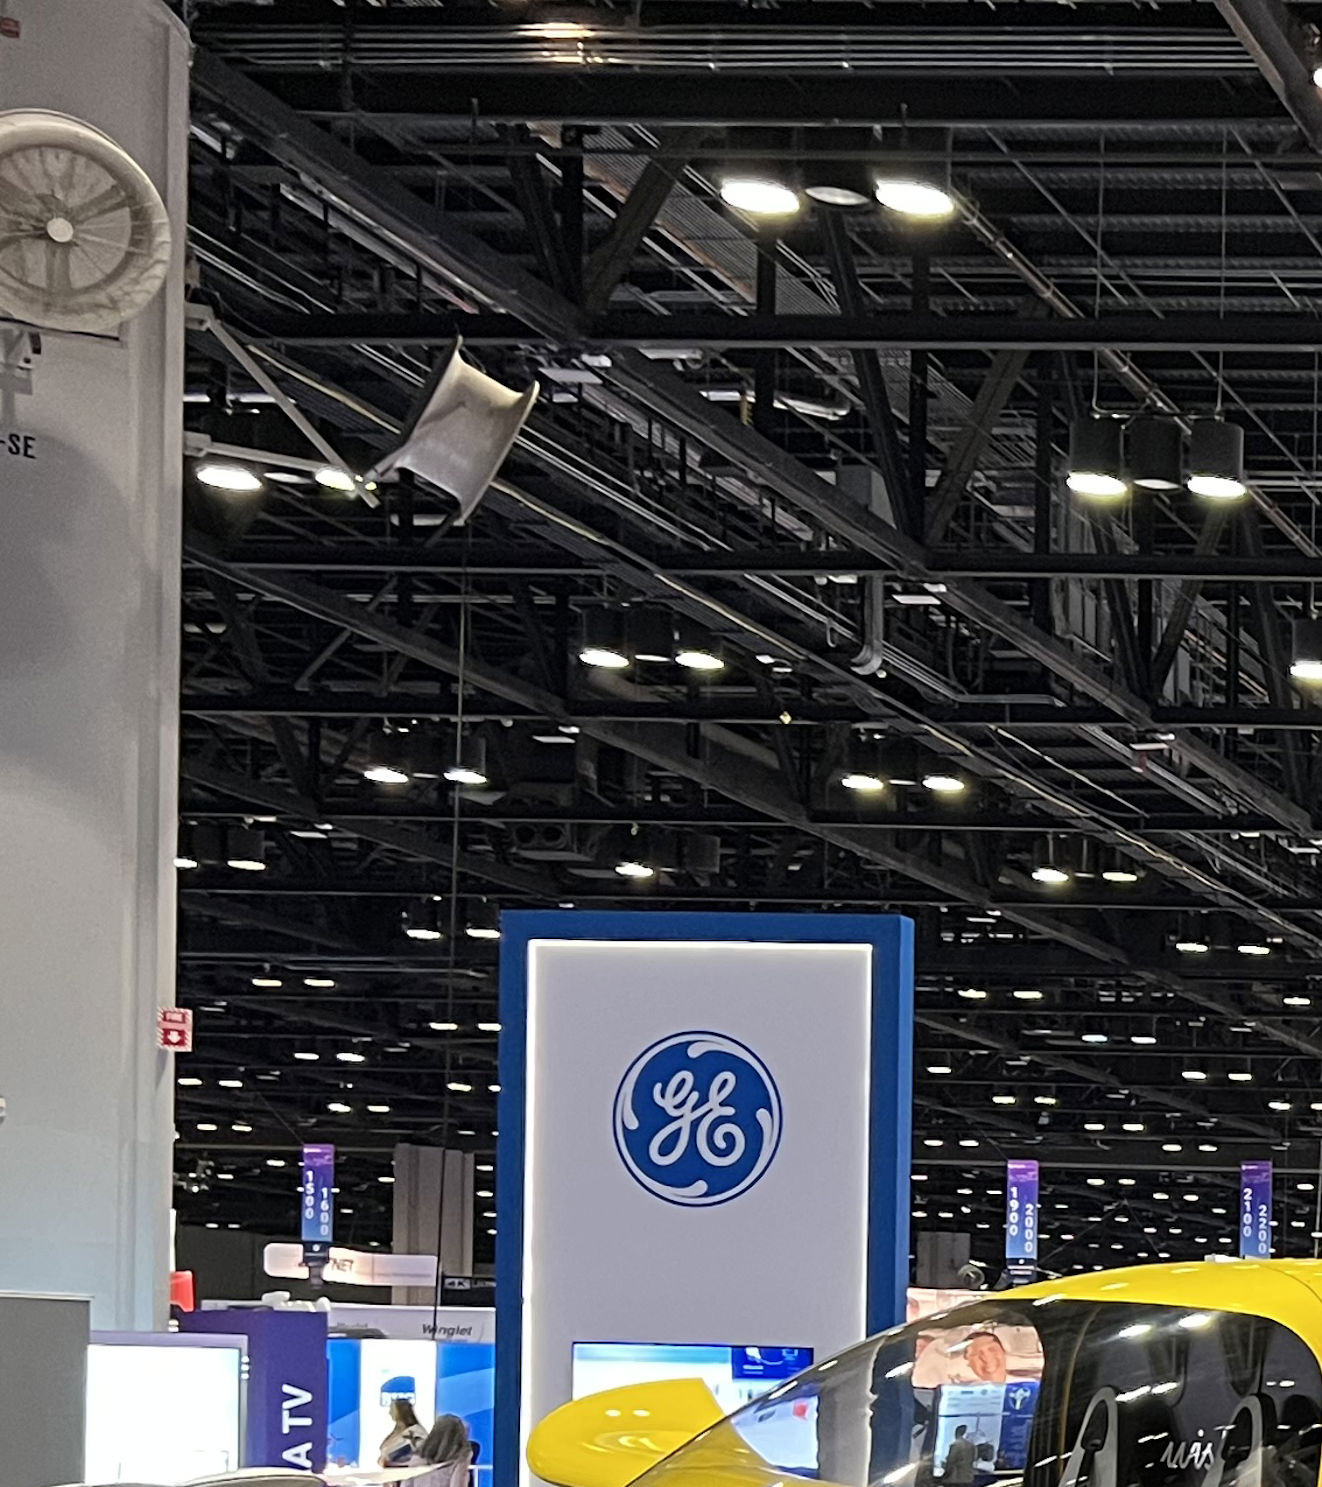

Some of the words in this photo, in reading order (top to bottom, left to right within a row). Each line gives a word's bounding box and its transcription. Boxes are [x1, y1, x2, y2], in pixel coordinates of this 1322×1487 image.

[304, 1170, 315, 1219] 1500
[320, 1187, 330, 1236] 1600
[1009, 1186, 1019, 1236] 1900
[1243, 1188, 1253, 1237] 2100
[1024, 1203, 1034, 1253] 2000
[1258, 1205, 1268, 1253] 2200
